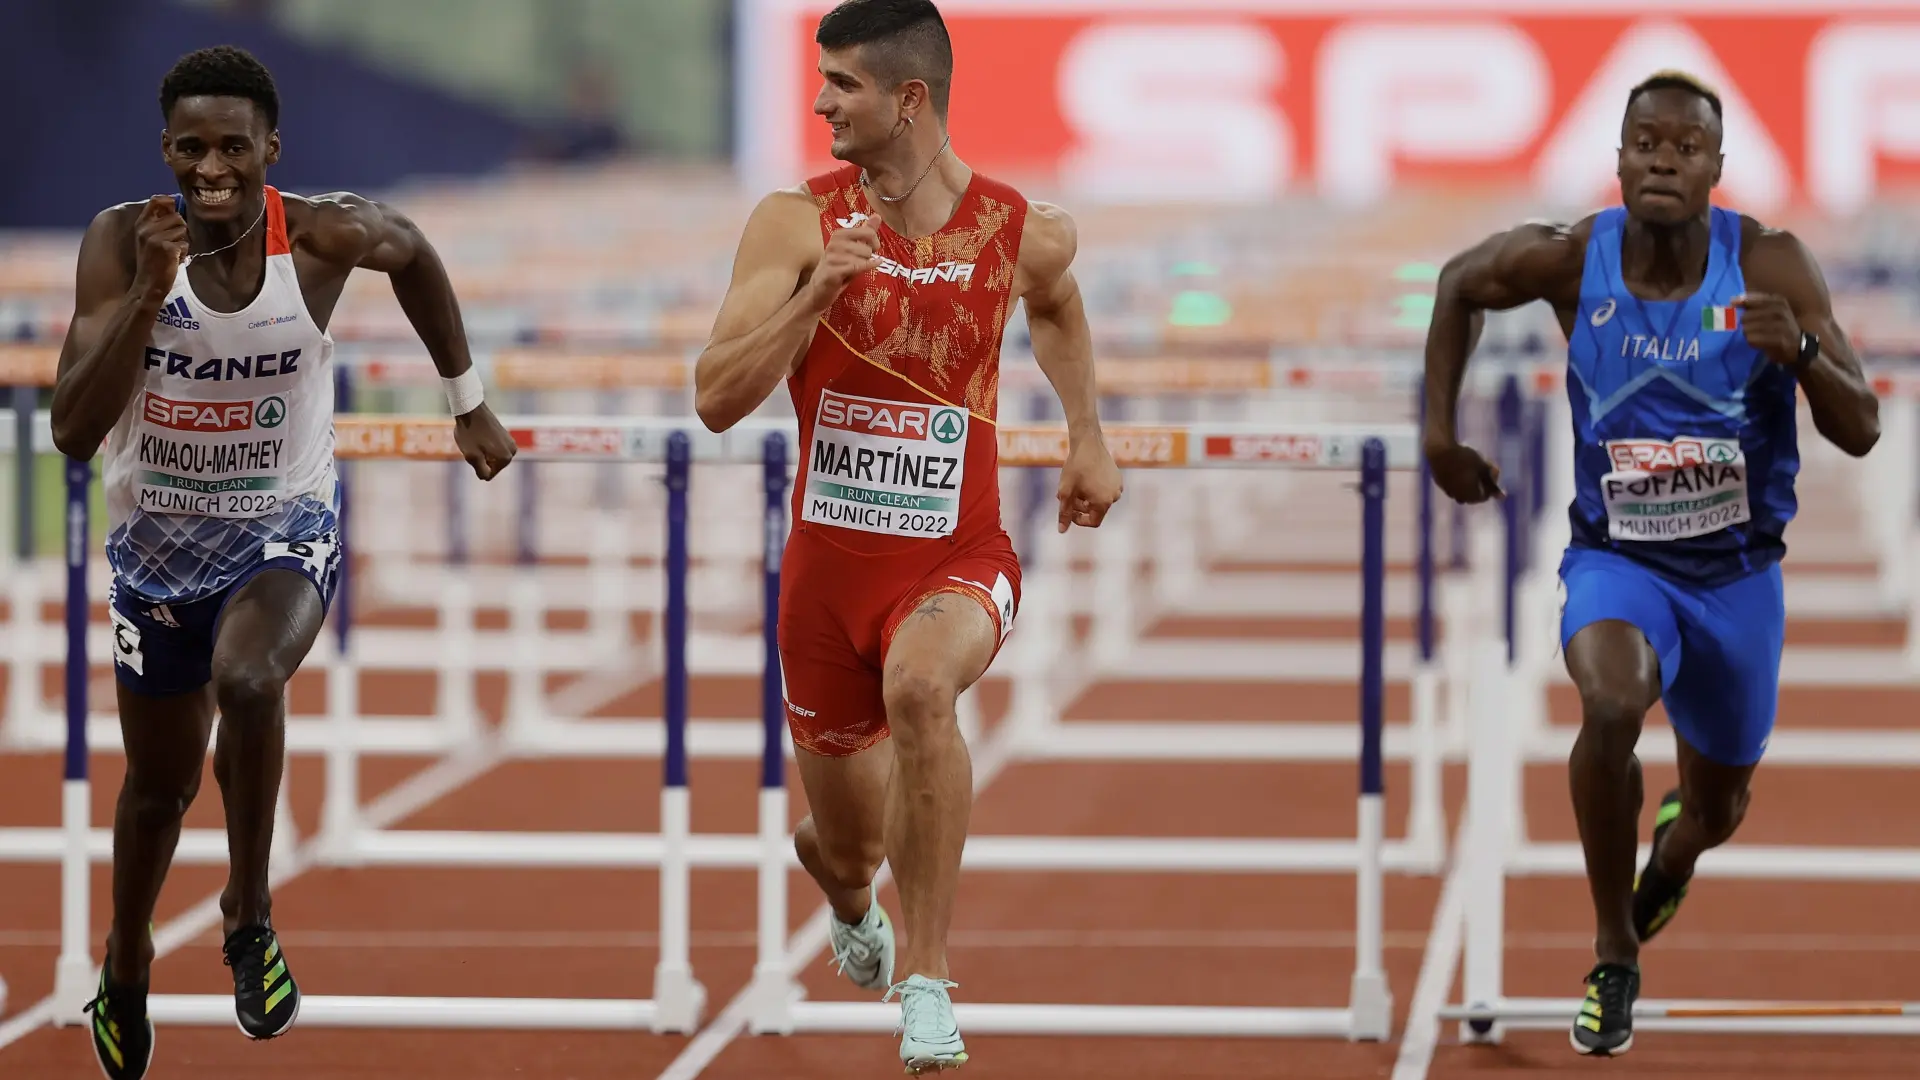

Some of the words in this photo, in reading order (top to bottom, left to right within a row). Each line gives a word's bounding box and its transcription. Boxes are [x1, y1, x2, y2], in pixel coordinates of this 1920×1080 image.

[871, 253, 975, 284] SPAÑA
[156, 314, 200, 331] adidas
[1621, 334, 1700, 362] ITALIA
[144, 346, 301, 381] FRANCE
[146, 398, 250, 428] SPAR
[822, 399, 926, 436] SPAR
[139, 433, 283, 475] KWAOU-MATHEY
[813, 440, 958, 490] MARTÍNEZ
[1613, 443, 1703, 472] SPAR
[177, 479, 204, 491] RUN
[847, 488, 874, 502] RUN
[140, 488, 220, 513] MUNICH
[228, 495, 277, 512] 2022
[812, 500, 891, 528] MUNICH
[899, 513, 948, 533] 2022
[1619, 516, 1691, 535] MUNICH
[1699, 504, 1741, 529] 2022
[788, 701, 816, 717] ESP
